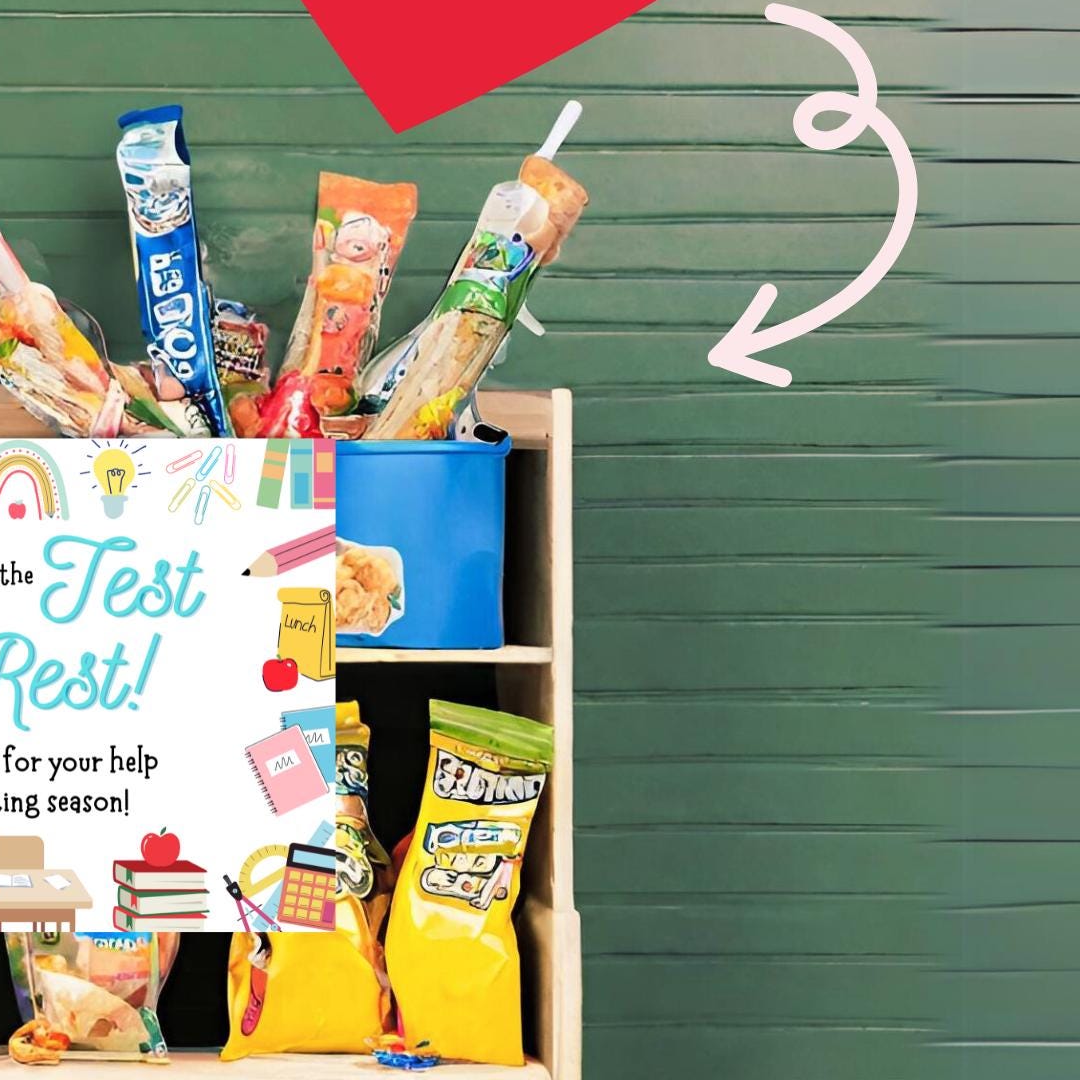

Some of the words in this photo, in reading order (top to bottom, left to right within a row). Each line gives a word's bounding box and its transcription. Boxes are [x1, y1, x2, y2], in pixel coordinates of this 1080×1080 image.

[39, 534, 207, 625] Test
[284, 613, 317, 633] Lunch
[2, 744, 43, 775] for
[47, 756, 104, 783] your
[109, 744, 160, 781] help
[47, 788, 130, 815] season!
